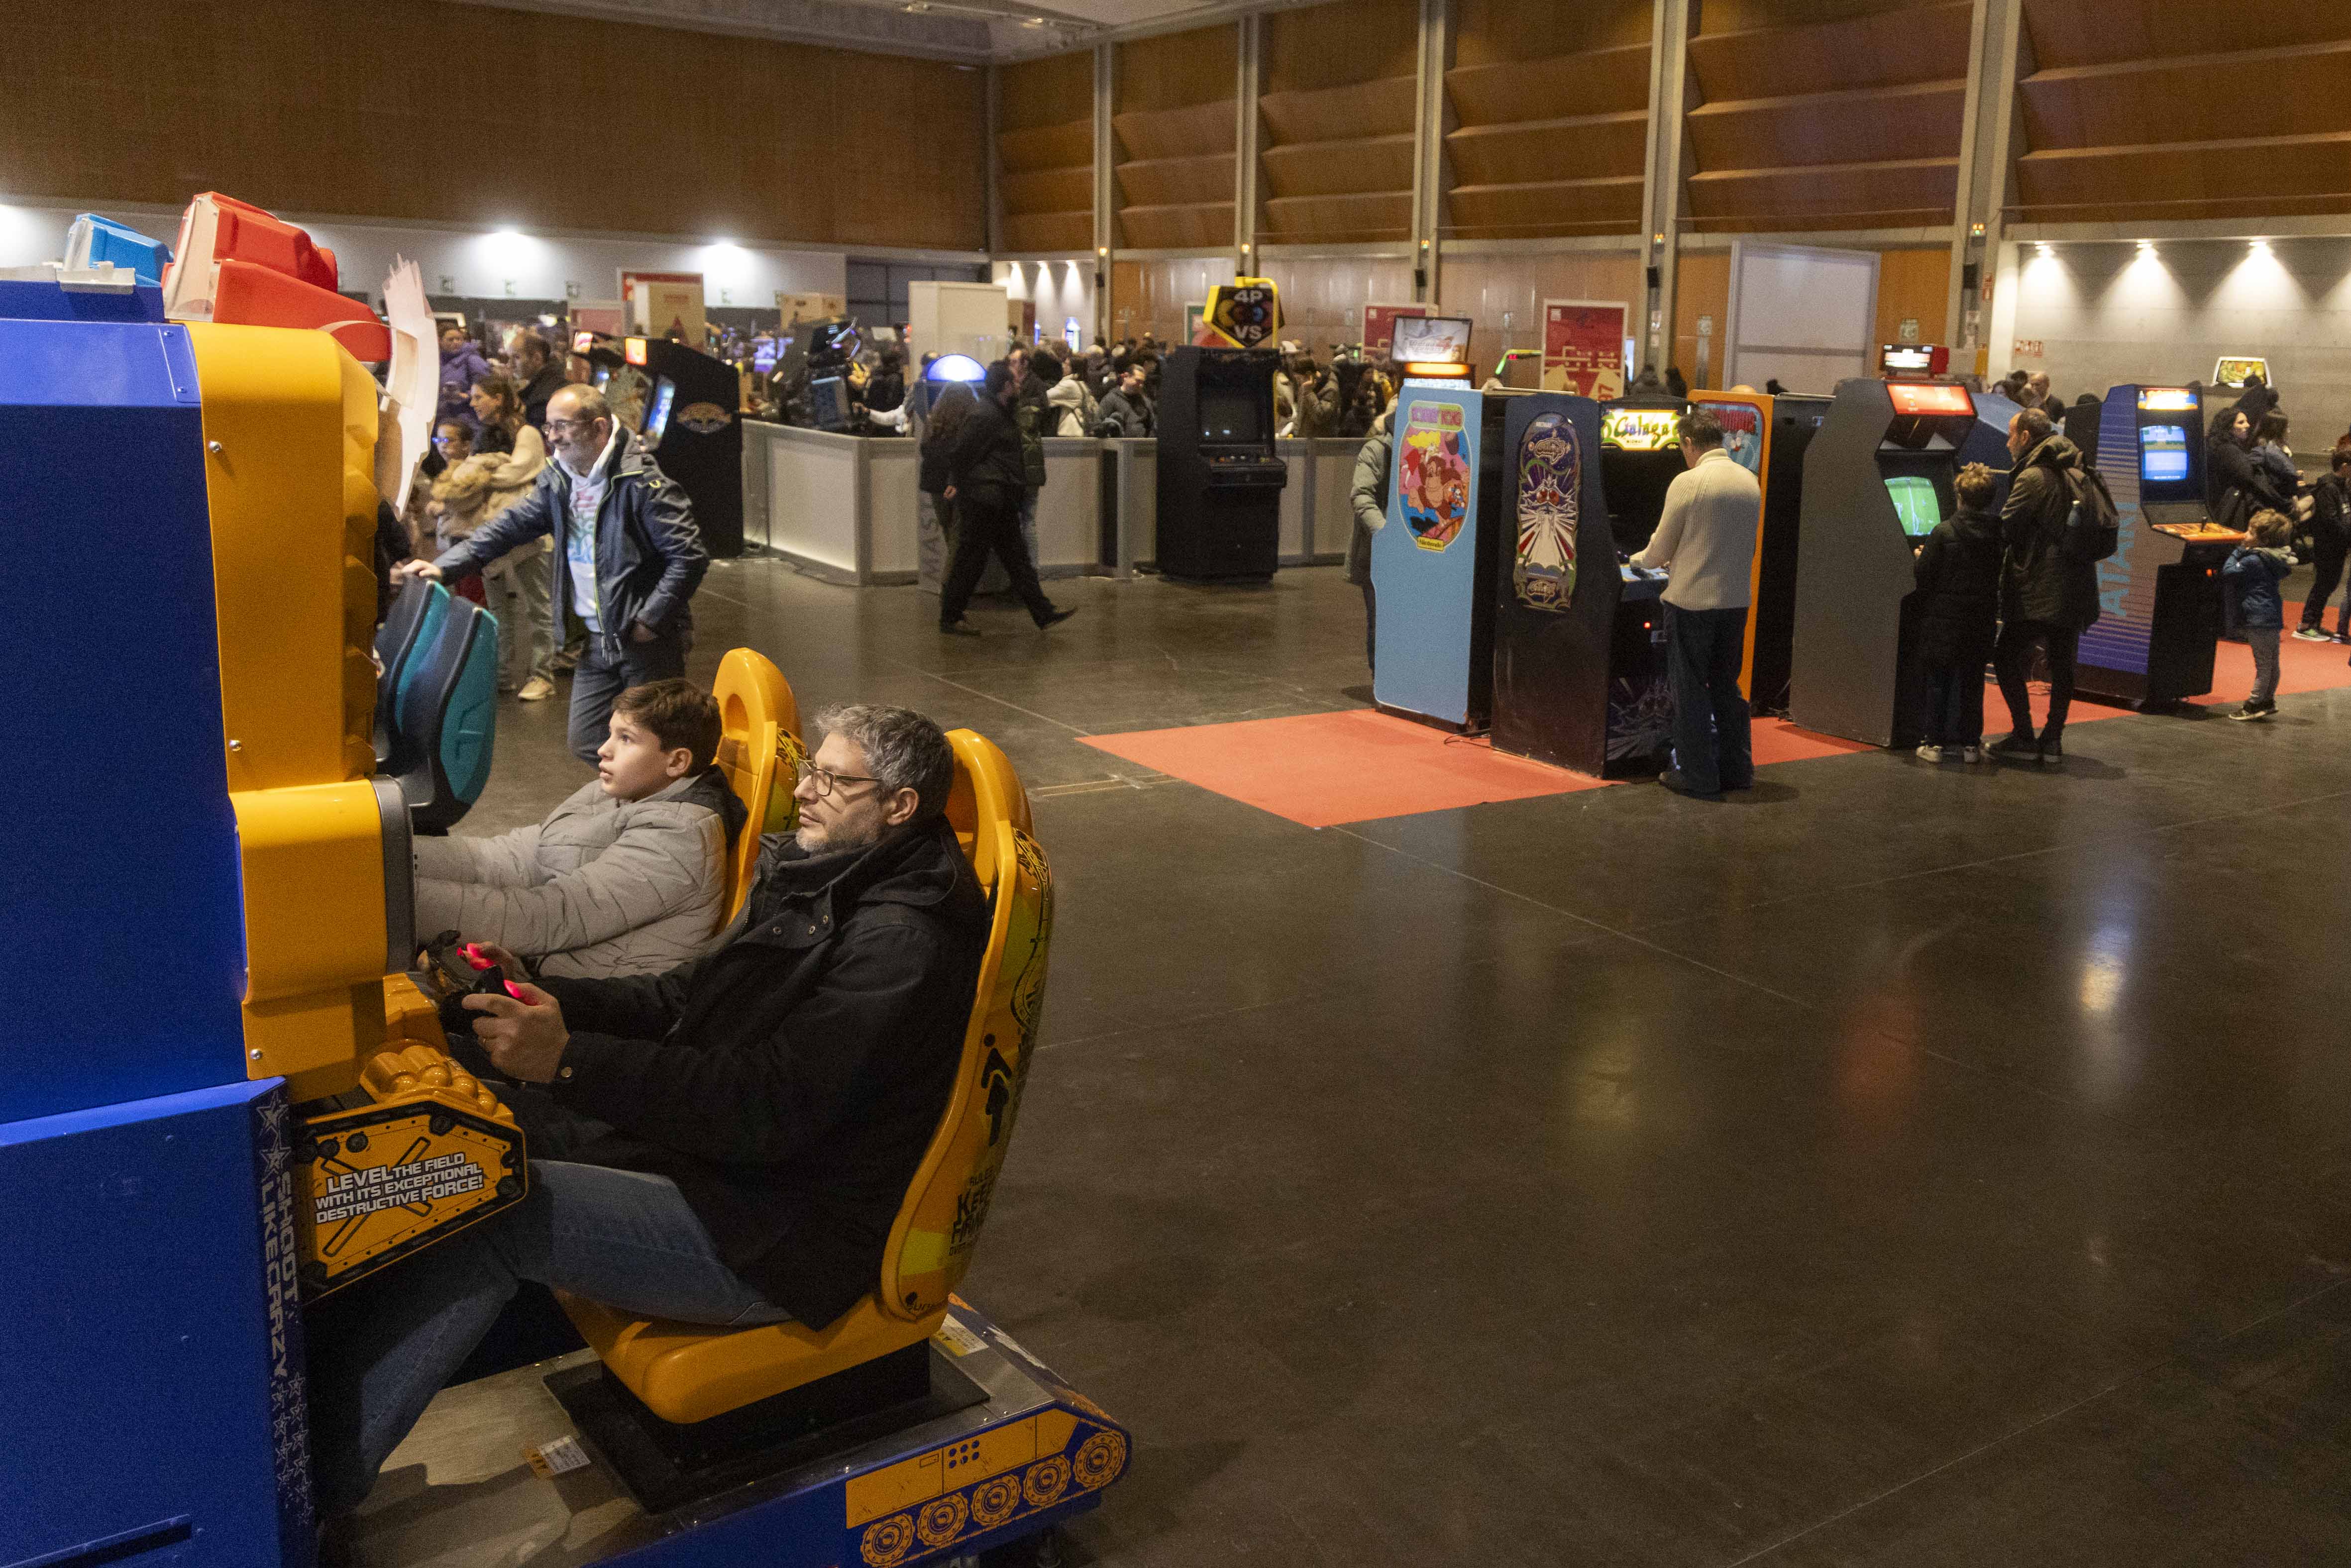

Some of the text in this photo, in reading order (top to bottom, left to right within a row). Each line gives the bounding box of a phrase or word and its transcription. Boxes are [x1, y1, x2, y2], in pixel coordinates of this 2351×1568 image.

[1234, 290, 1263, 303] 4P
[1234, 325, 1263, 339] VS
[1614, 414, 1670, 448] Galaga
[316, 1163, 482, 1209] WITH ITS EXCEPTIONAL
[327, 1152, 465, 1193] LEVEL THE FIELD
[316, 1175, 484, 1223] DESTRUCTIVE FORCE!
[278, 1171, 298, 1302] SHOOT
